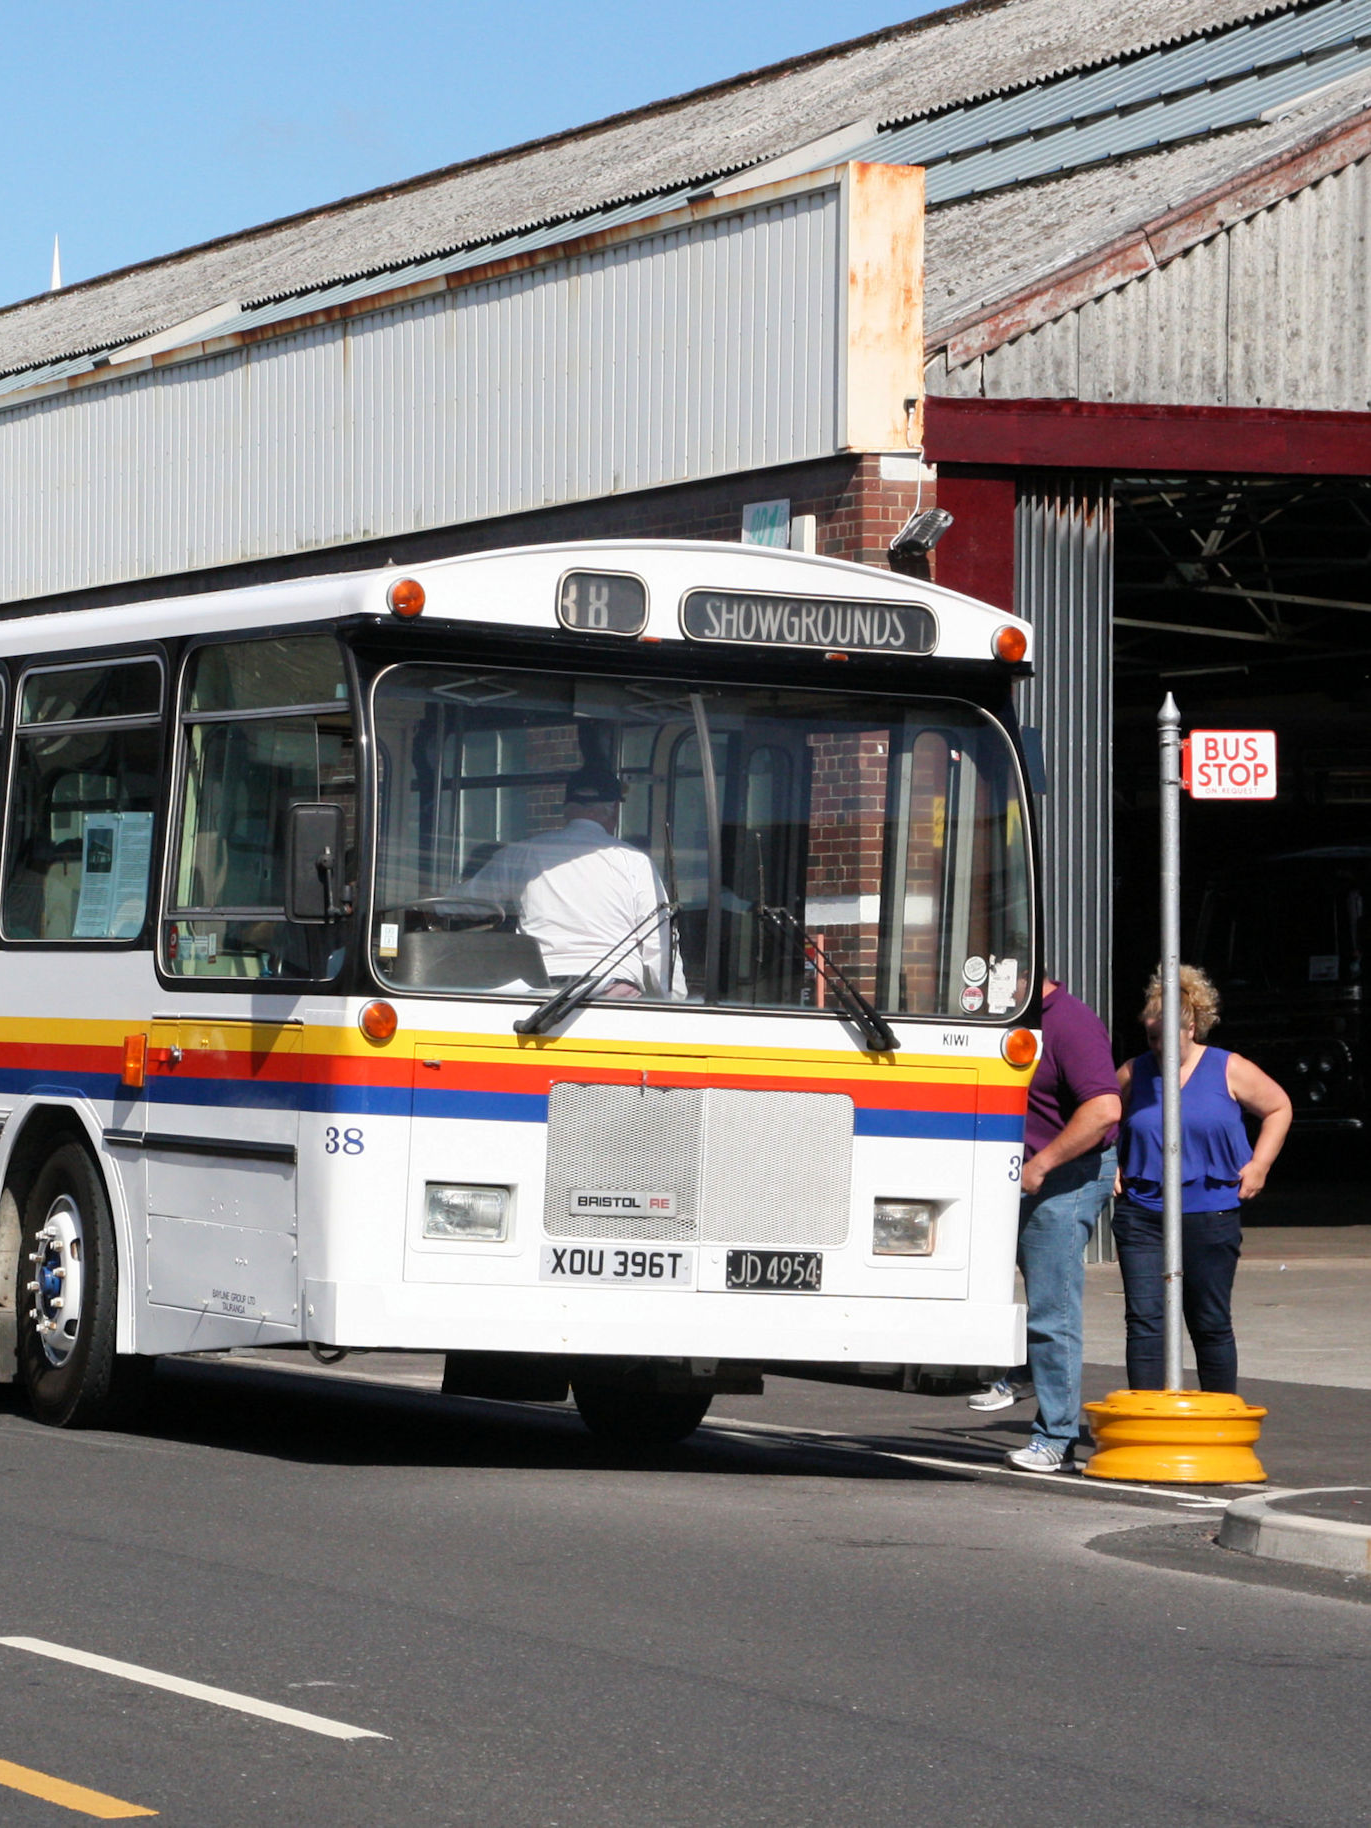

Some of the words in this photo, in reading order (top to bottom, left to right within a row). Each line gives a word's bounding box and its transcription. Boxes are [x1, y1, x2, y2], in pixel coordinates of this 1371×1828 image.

[704, 600, 906, 646] SHOWGROUNDS
[1204, 737, 1258, 761] BUS
[1197, 763, 1269, 787] STOP
[942, 1033, 969, 1047] KIWI
[325, 1126, 365, 1156] 38
[577, 1196, 641, 1209] BRISTOL
[649, 1197, 670, 1209] RE
[551, 1248, 604, 1276] XOU
[613, 1250, 682, 1279] 396T
[731, 1254, 762, 1284] JD
[766, 1256, 818, 1286] 4954
